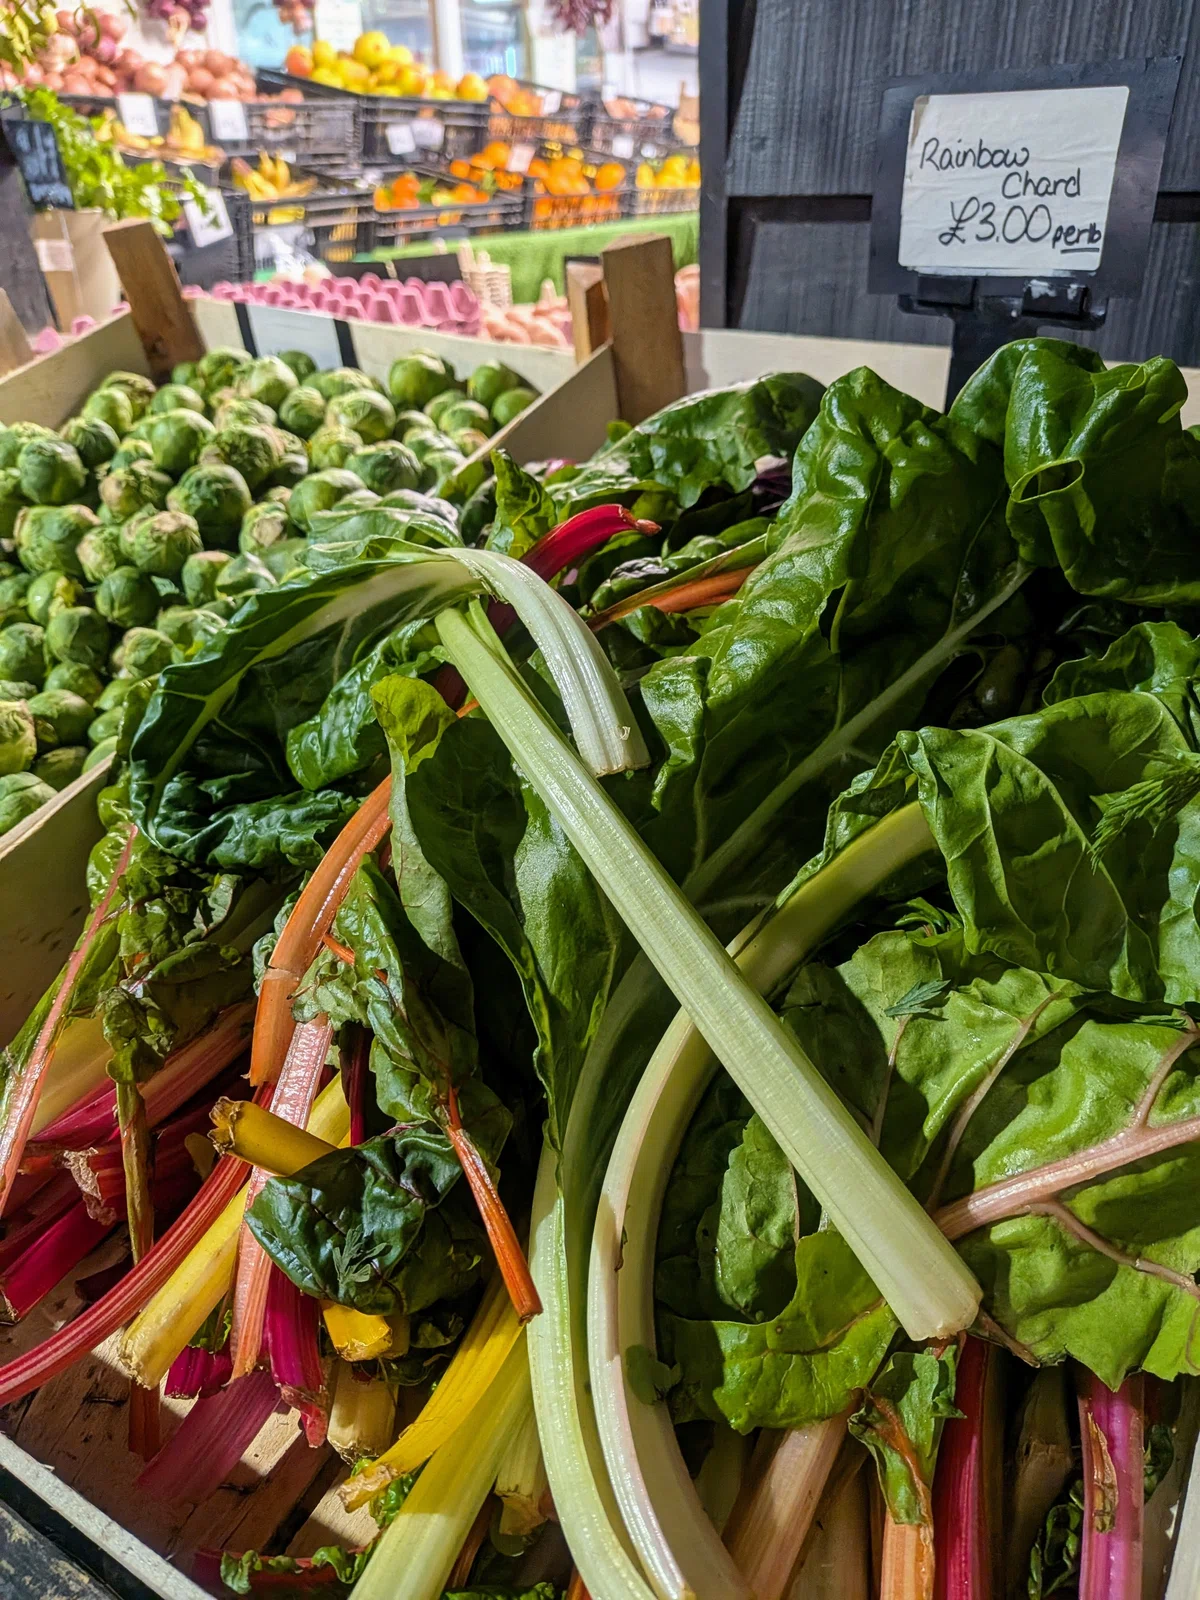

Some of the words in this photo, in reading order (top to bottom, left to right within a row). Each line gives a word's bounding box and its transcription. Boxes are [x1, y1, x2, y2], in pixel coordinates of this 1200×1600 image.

[920, 137, 1029, 170] Rainbow
[1001, 167, 1081, 199] Chard
[938, 196, 1052, 246] £3.00
